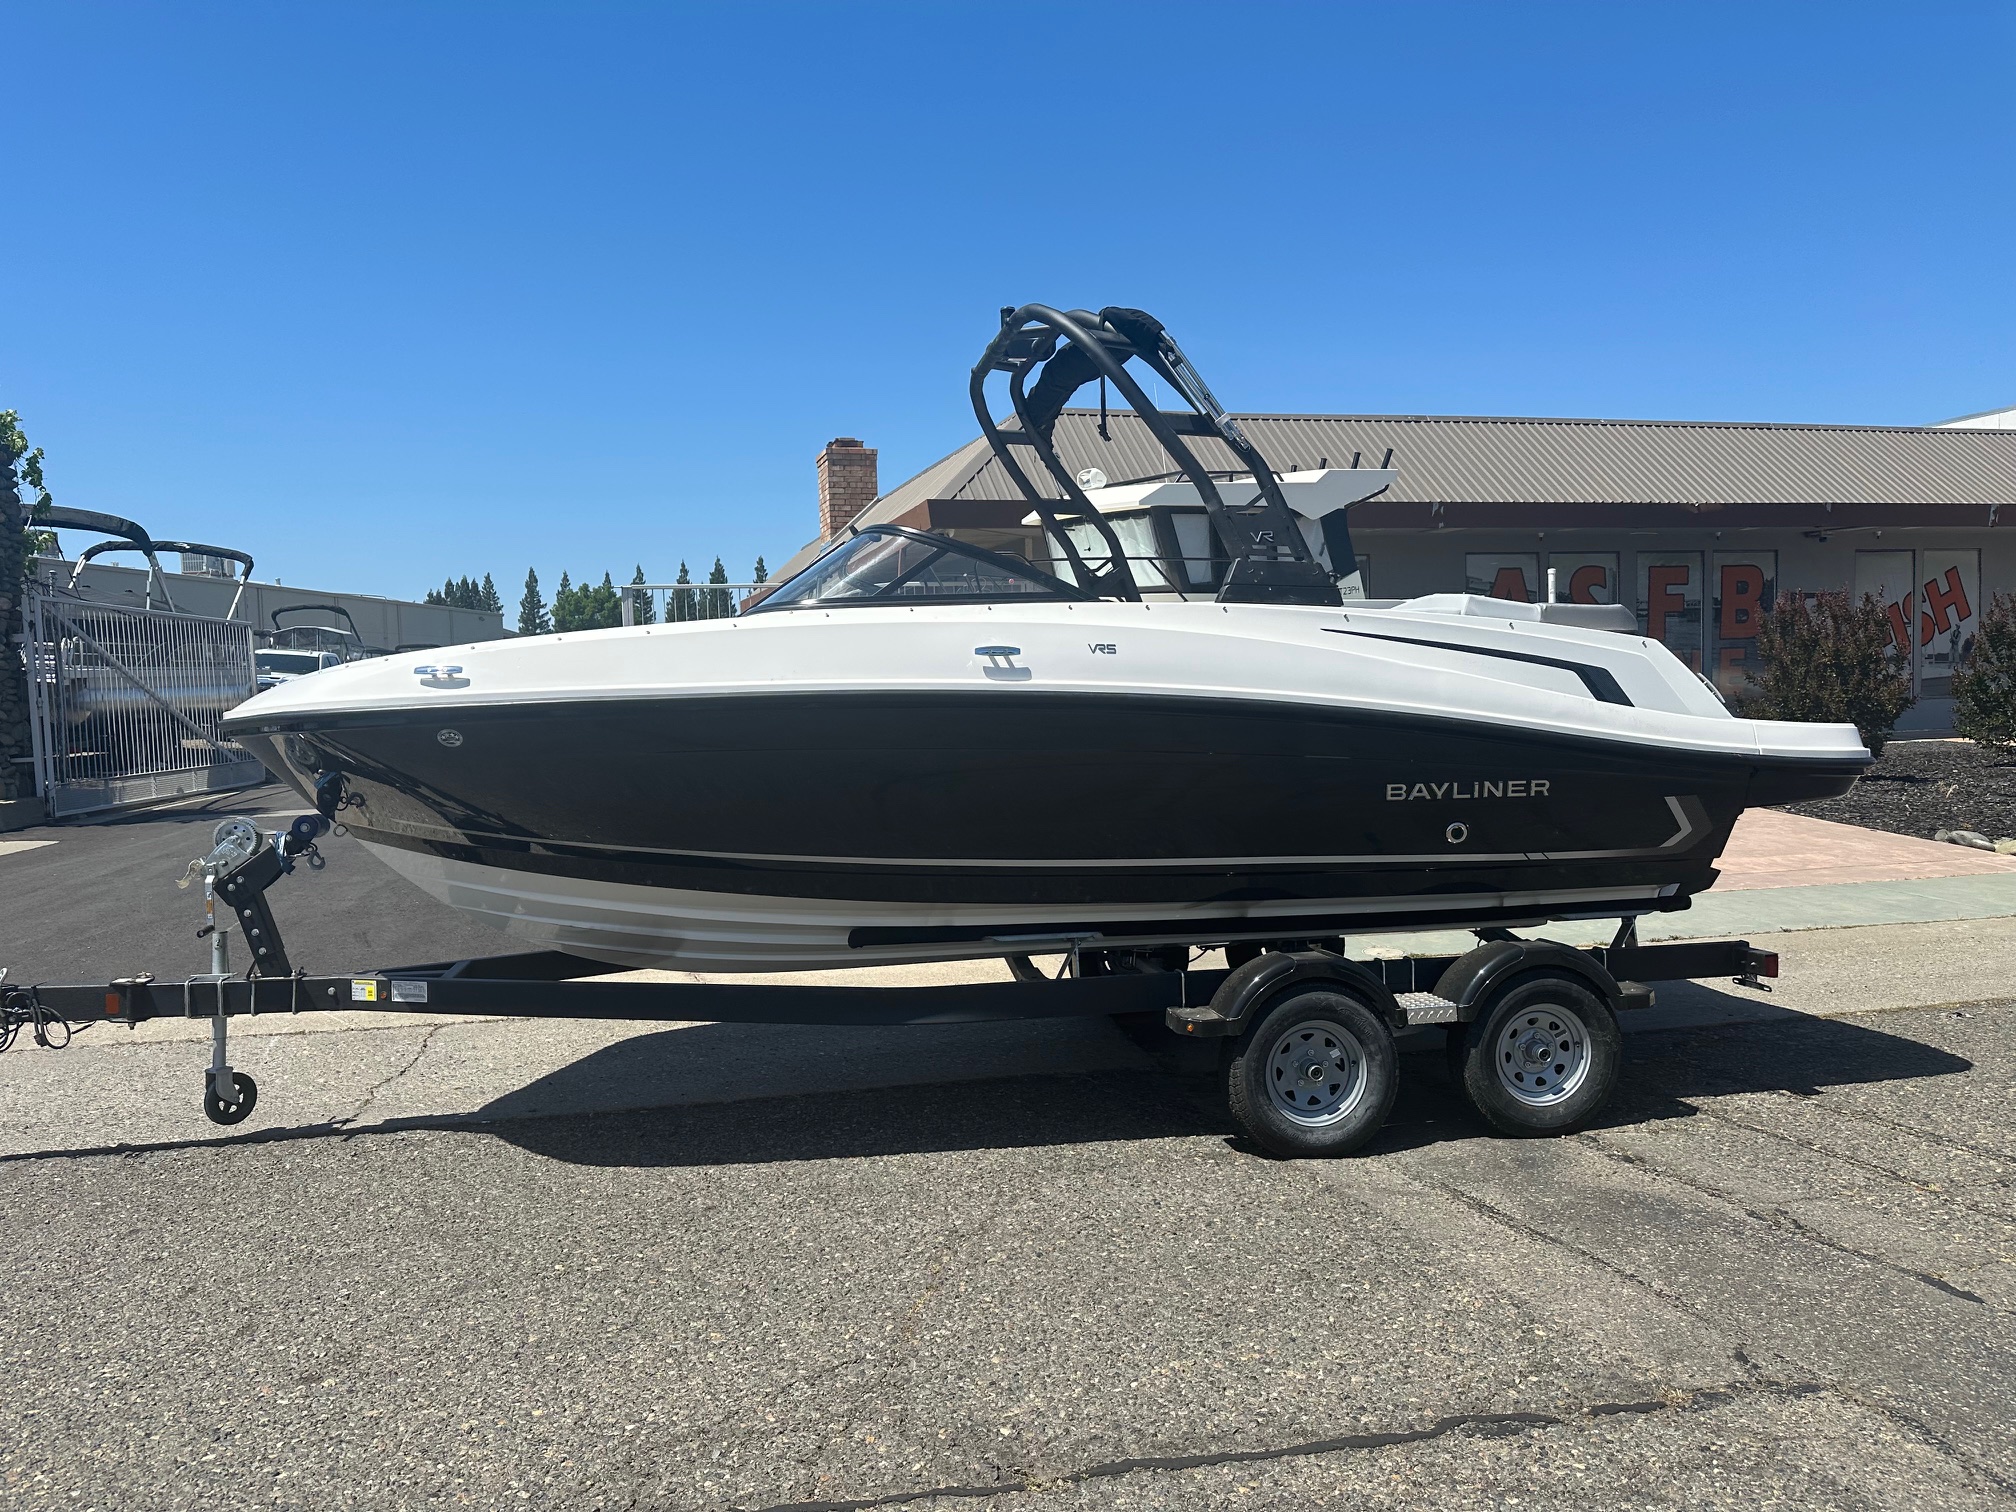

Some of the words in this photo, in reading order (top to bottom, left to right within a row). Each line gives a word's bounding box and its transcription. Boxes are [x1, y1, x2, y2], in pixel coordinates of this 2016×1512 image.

[1250, 531, 1274, 542] VR
[1338, 585, 1360, 596] 23PH
[1884, 565, 1972, 656] ISH
[1386, 779, 1551, 801] BAYLINER
